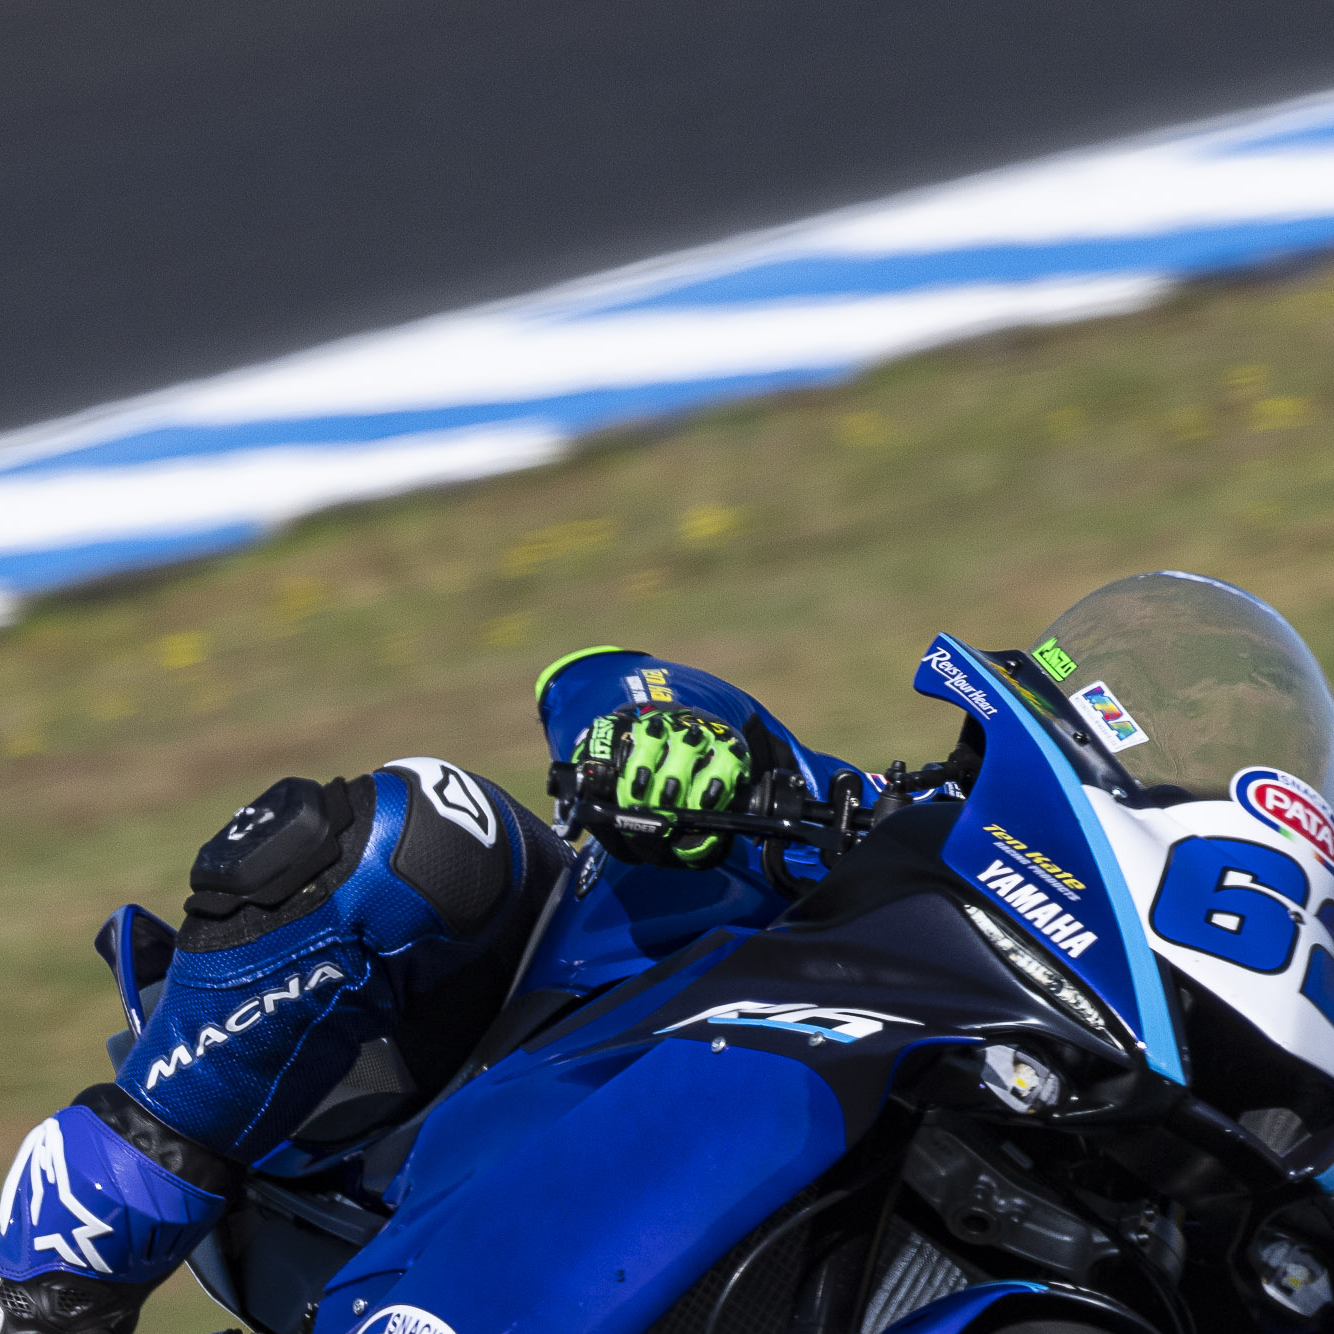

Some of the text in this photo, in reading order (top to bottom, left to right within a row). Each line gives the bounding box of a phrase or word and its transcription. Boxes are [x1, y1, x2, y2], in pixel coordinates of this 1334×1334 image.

[983, 824, 1086, 890] Ten Kate
[1265, 788, 1334, 857] PATA
[977, 860, 1098, 958] YAMAHA
[146, 965, 344, 1090] MACNA
